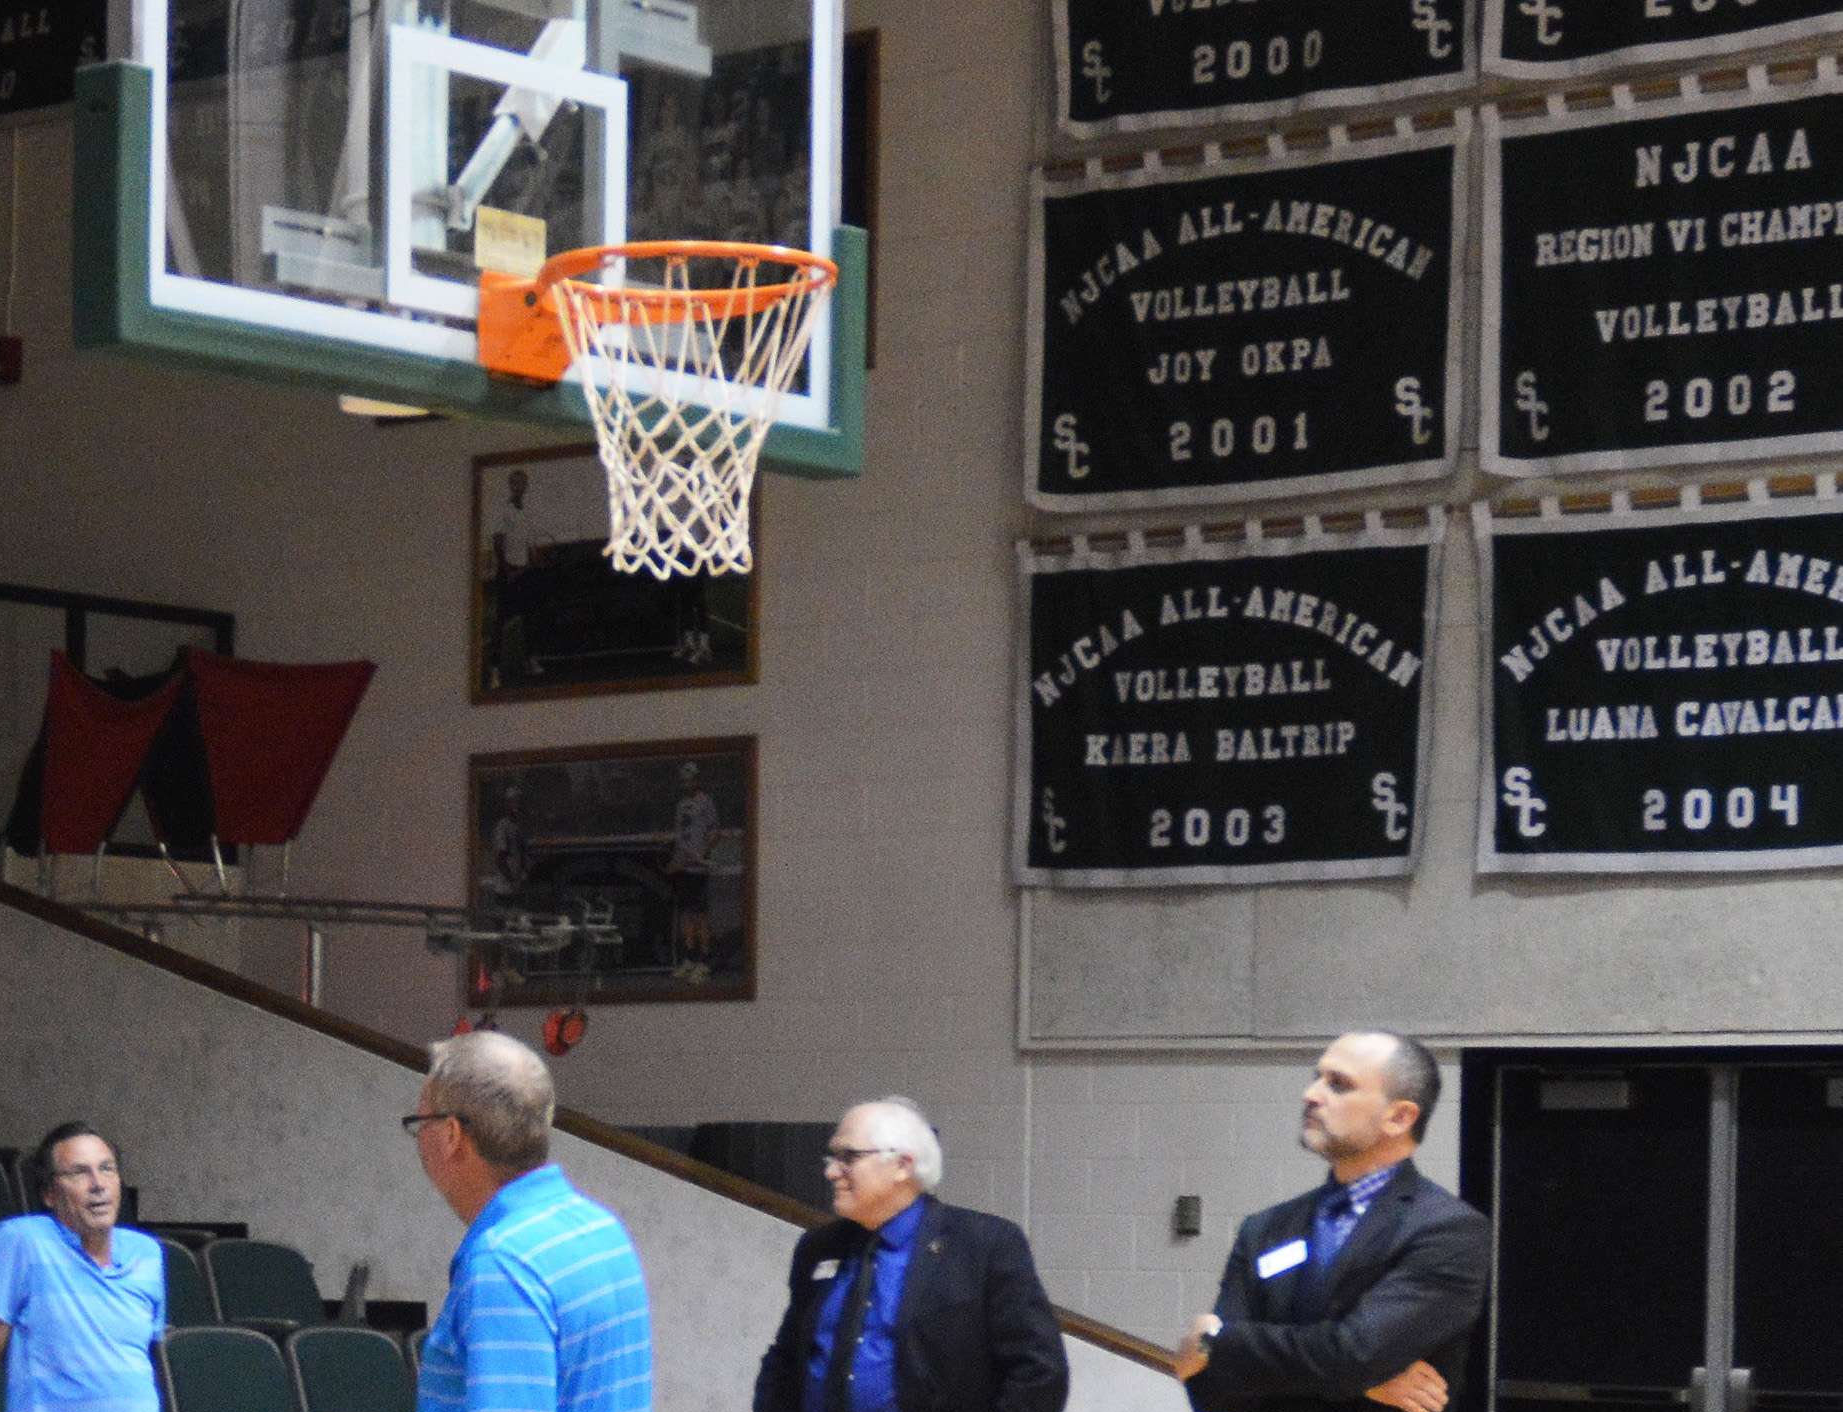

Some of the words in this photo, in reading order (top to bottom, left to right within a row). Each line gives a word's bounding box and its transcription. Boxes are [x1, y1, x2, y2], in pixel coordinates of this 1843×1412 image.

[1193, 30, 1322, 83] 2000
[1636, 129, 1811, 187] NJCAA
[1061, 230, 1161, 322] NJCAA
[1179, 201, 1432, 278] ALL-AMERICAN
[1536, 223, 1653, 266] REGION
[1668, 218, 1705, 252] VI
[1130, 269, 1350, 322] VOLLEYBALL
[1596, 284, 1843, 342] VOLLEYBALL
[1148, 349, 1216, 384] JOY
[1242, 338, 1331, 376] OKPA
[1646, 370, 1795, 421] 2002
[1170, 412, 1308, 460] 2001
[1033, 610, 1143, 706] NJCAA
[1161, 587, 1422, 683] ALL-AMERICAN
[1501, 578, 1625, 682] NJCAA
[1597, 627, 1843, 671] VOLLEYBALL
[1116, 660, 1330, 701] VOLLEYBALL
[1216, 721, 1355, 761] BALTRIP
[1547, 705, 1658, 741] LUANA
[1676, 695, 1843, 736] CAVALCA
[1151, 805, 1284, 846] 2003
[1644, 785, 1798, 830] 2004
